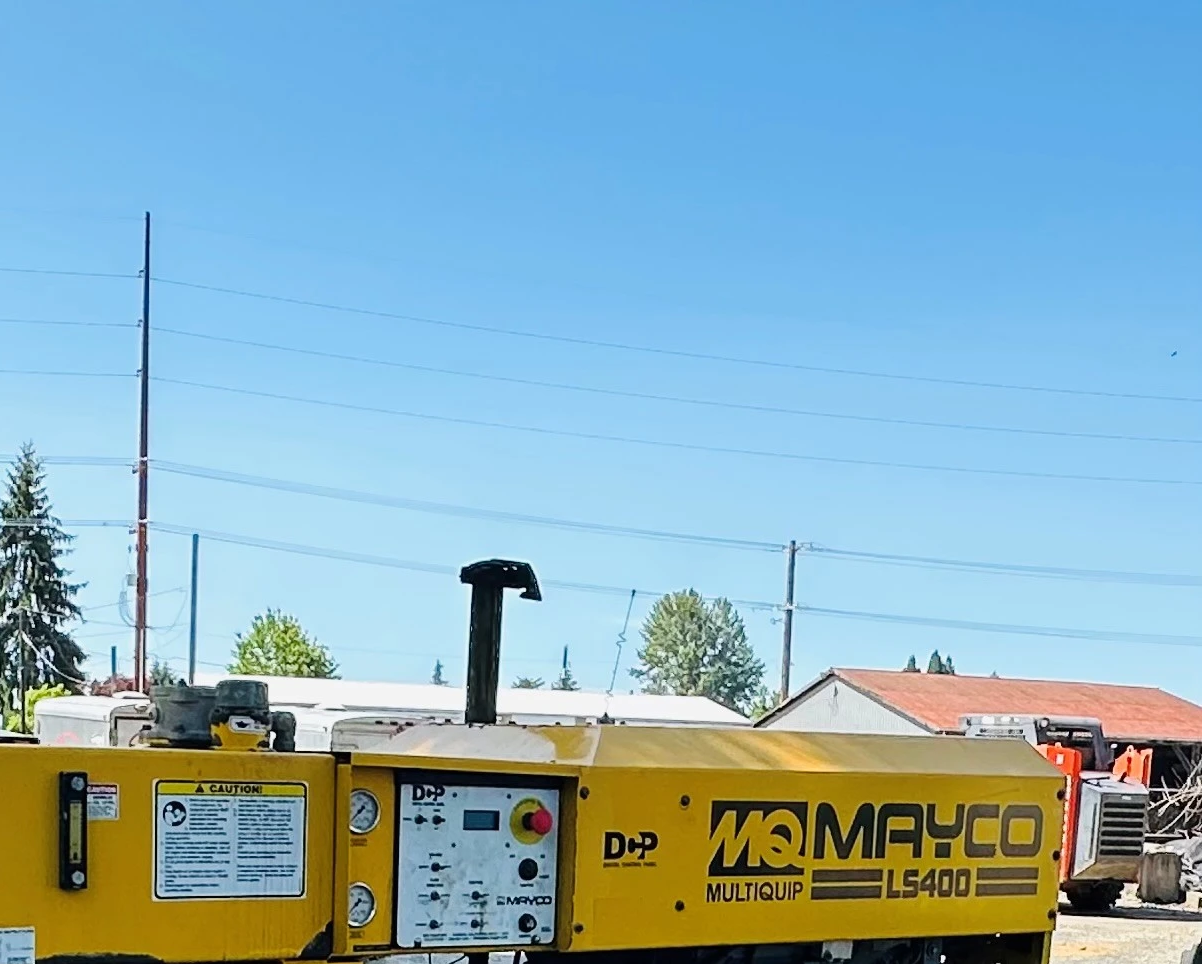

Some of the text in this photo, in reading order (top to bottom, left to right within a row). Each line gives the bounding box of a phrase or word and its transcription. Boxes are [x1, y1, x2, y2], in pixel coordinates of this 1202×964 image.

[209, 784, 263, 794] CAUTION!
[707, 800, 808, 877] MQ
[813, 802, 1044, 860] MAYCO
[706, 881, 804, 904] MULTIQUIP
[886, 868, 971, 899] LS400
[506, 895, 552, 906] MAYCO
